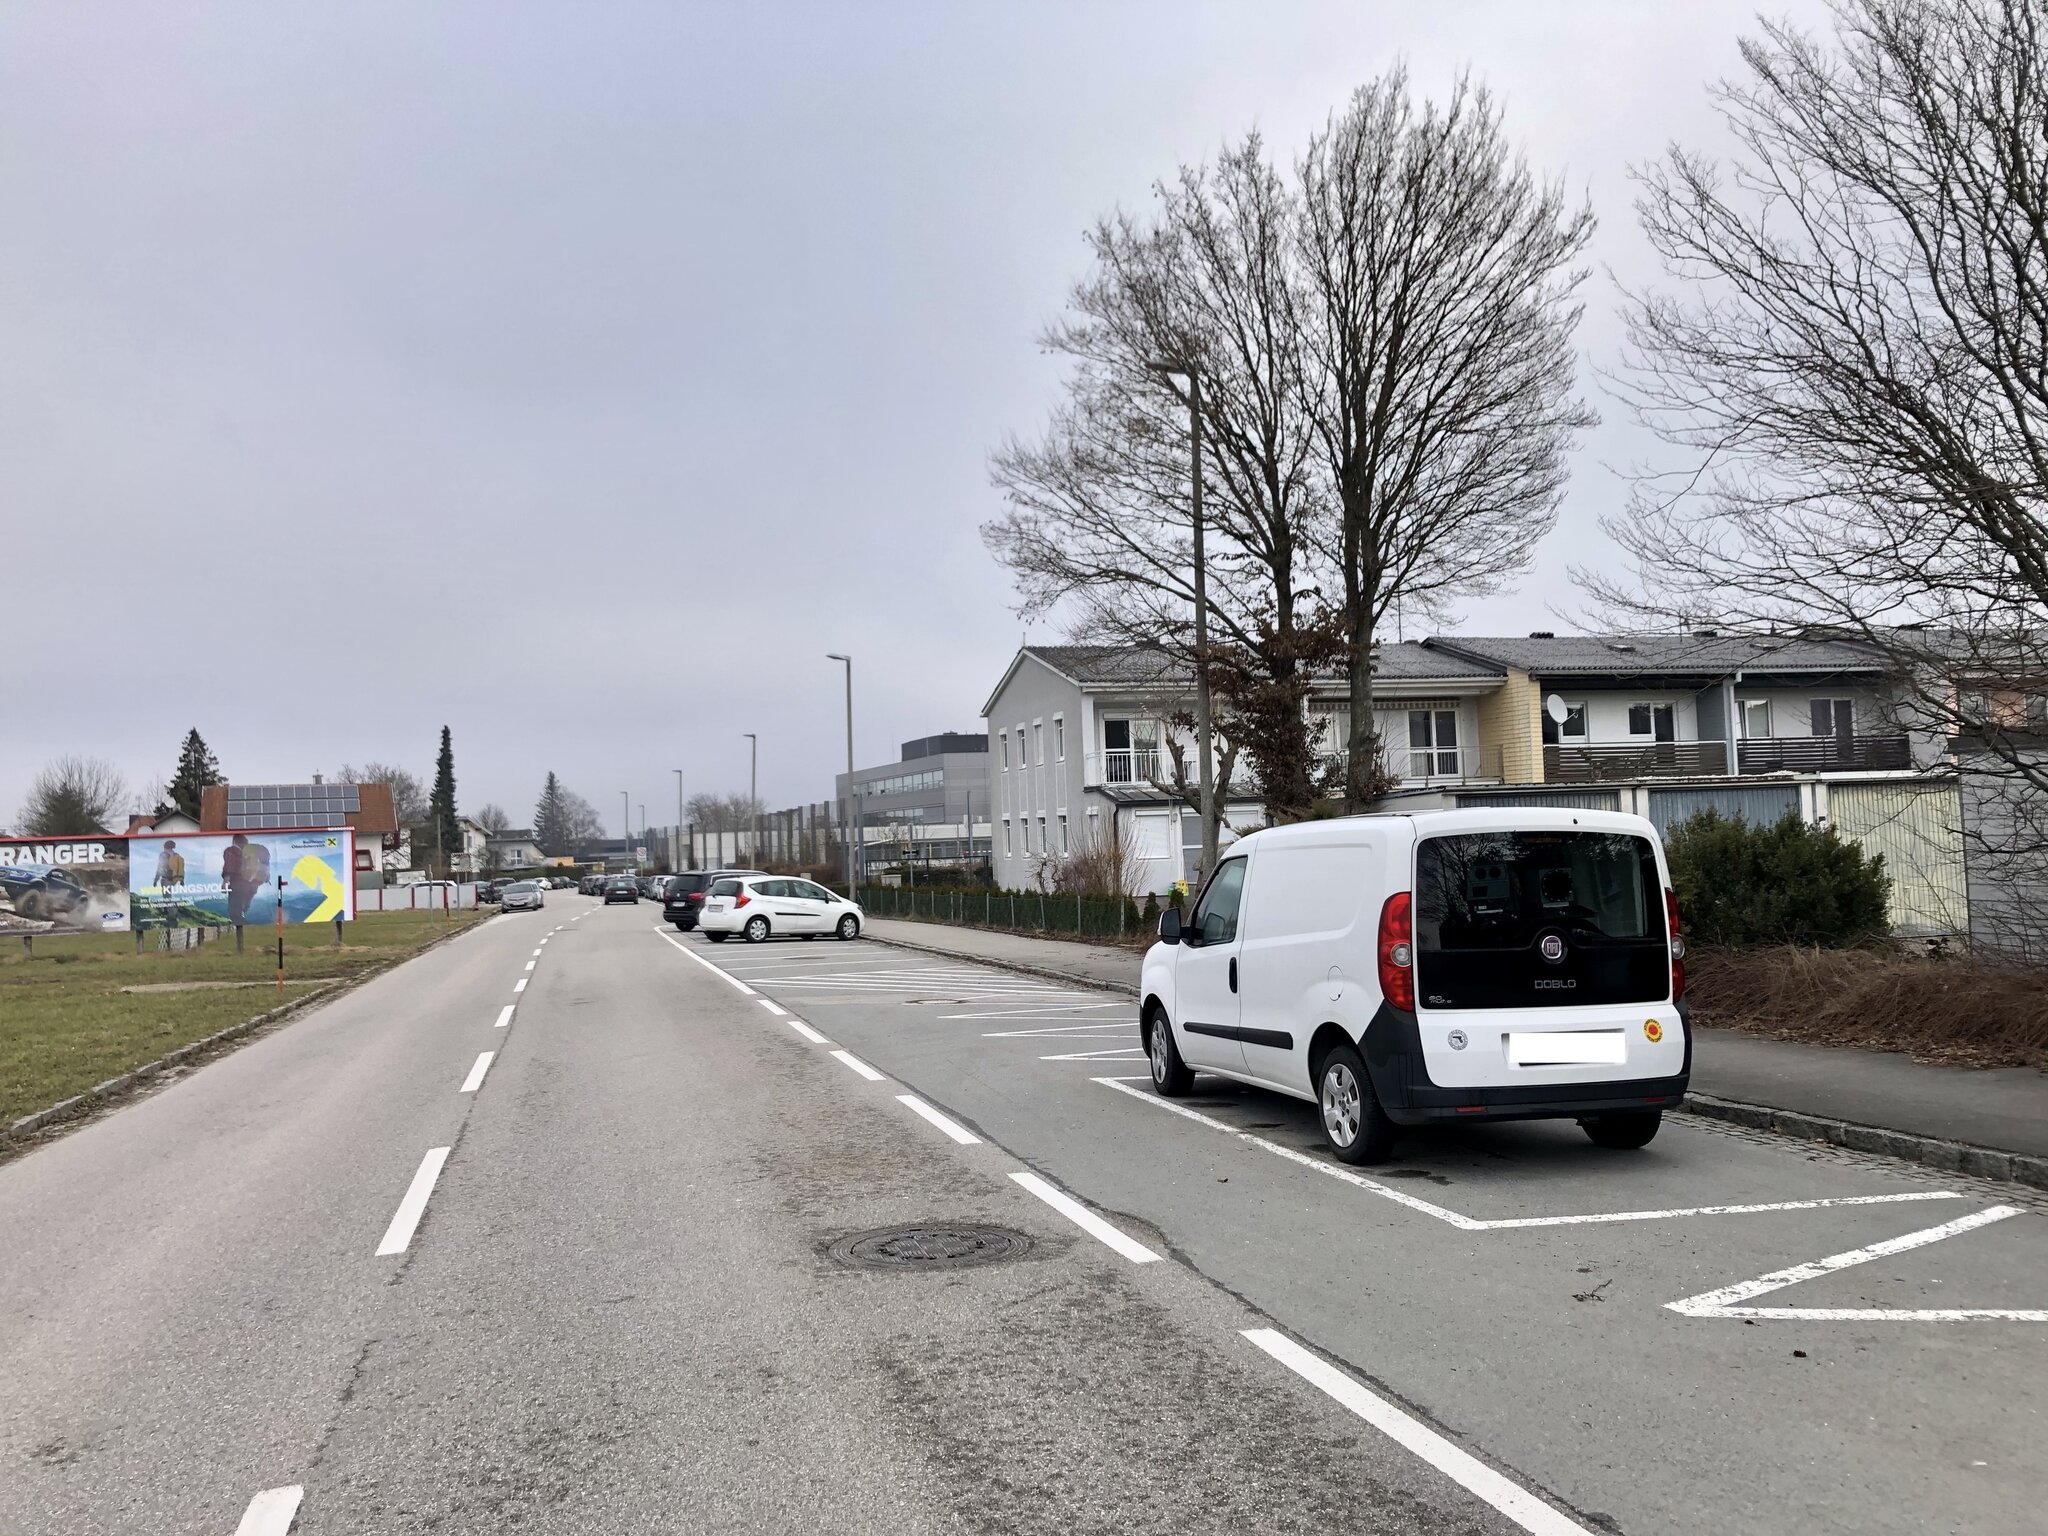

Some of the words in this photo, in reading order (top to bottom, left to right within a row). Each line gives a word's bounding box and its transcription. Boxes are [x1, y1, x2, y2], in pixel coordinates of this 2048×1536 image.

[0, 843, 105, 866] RANGER
[1546, 942, 1559, 953] FIAT
[1534, 979, 1577, 989] DOBLO
